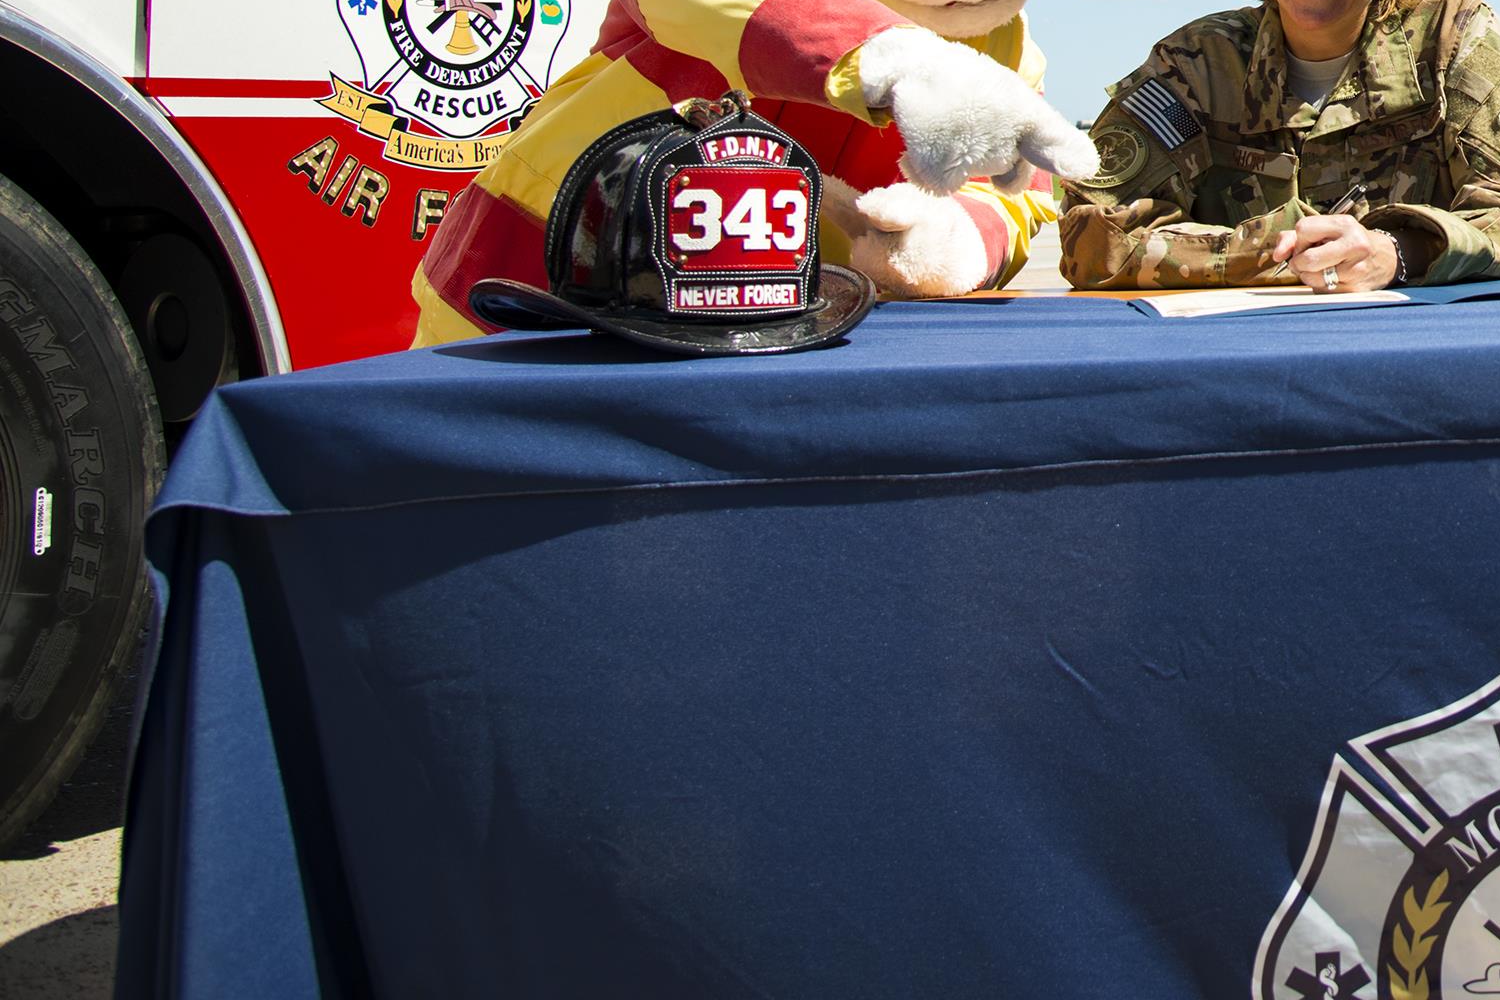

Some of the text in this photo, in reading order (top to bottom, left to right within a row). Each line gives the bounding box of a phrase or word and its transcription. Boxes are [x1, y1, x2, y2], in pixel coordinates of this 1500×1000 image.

[390, 19, 527, 86] FIRE DEPARTMENT
[336, 89, 365, 113] EST.
[414, 88, 507, 119] RESCUE
[390, 134, 464, 164] America's
[286, 135, 391, 229] AIR
[672, 188, 808, 251] 343
[680, 284, 796, 307] NEVER FORGET
